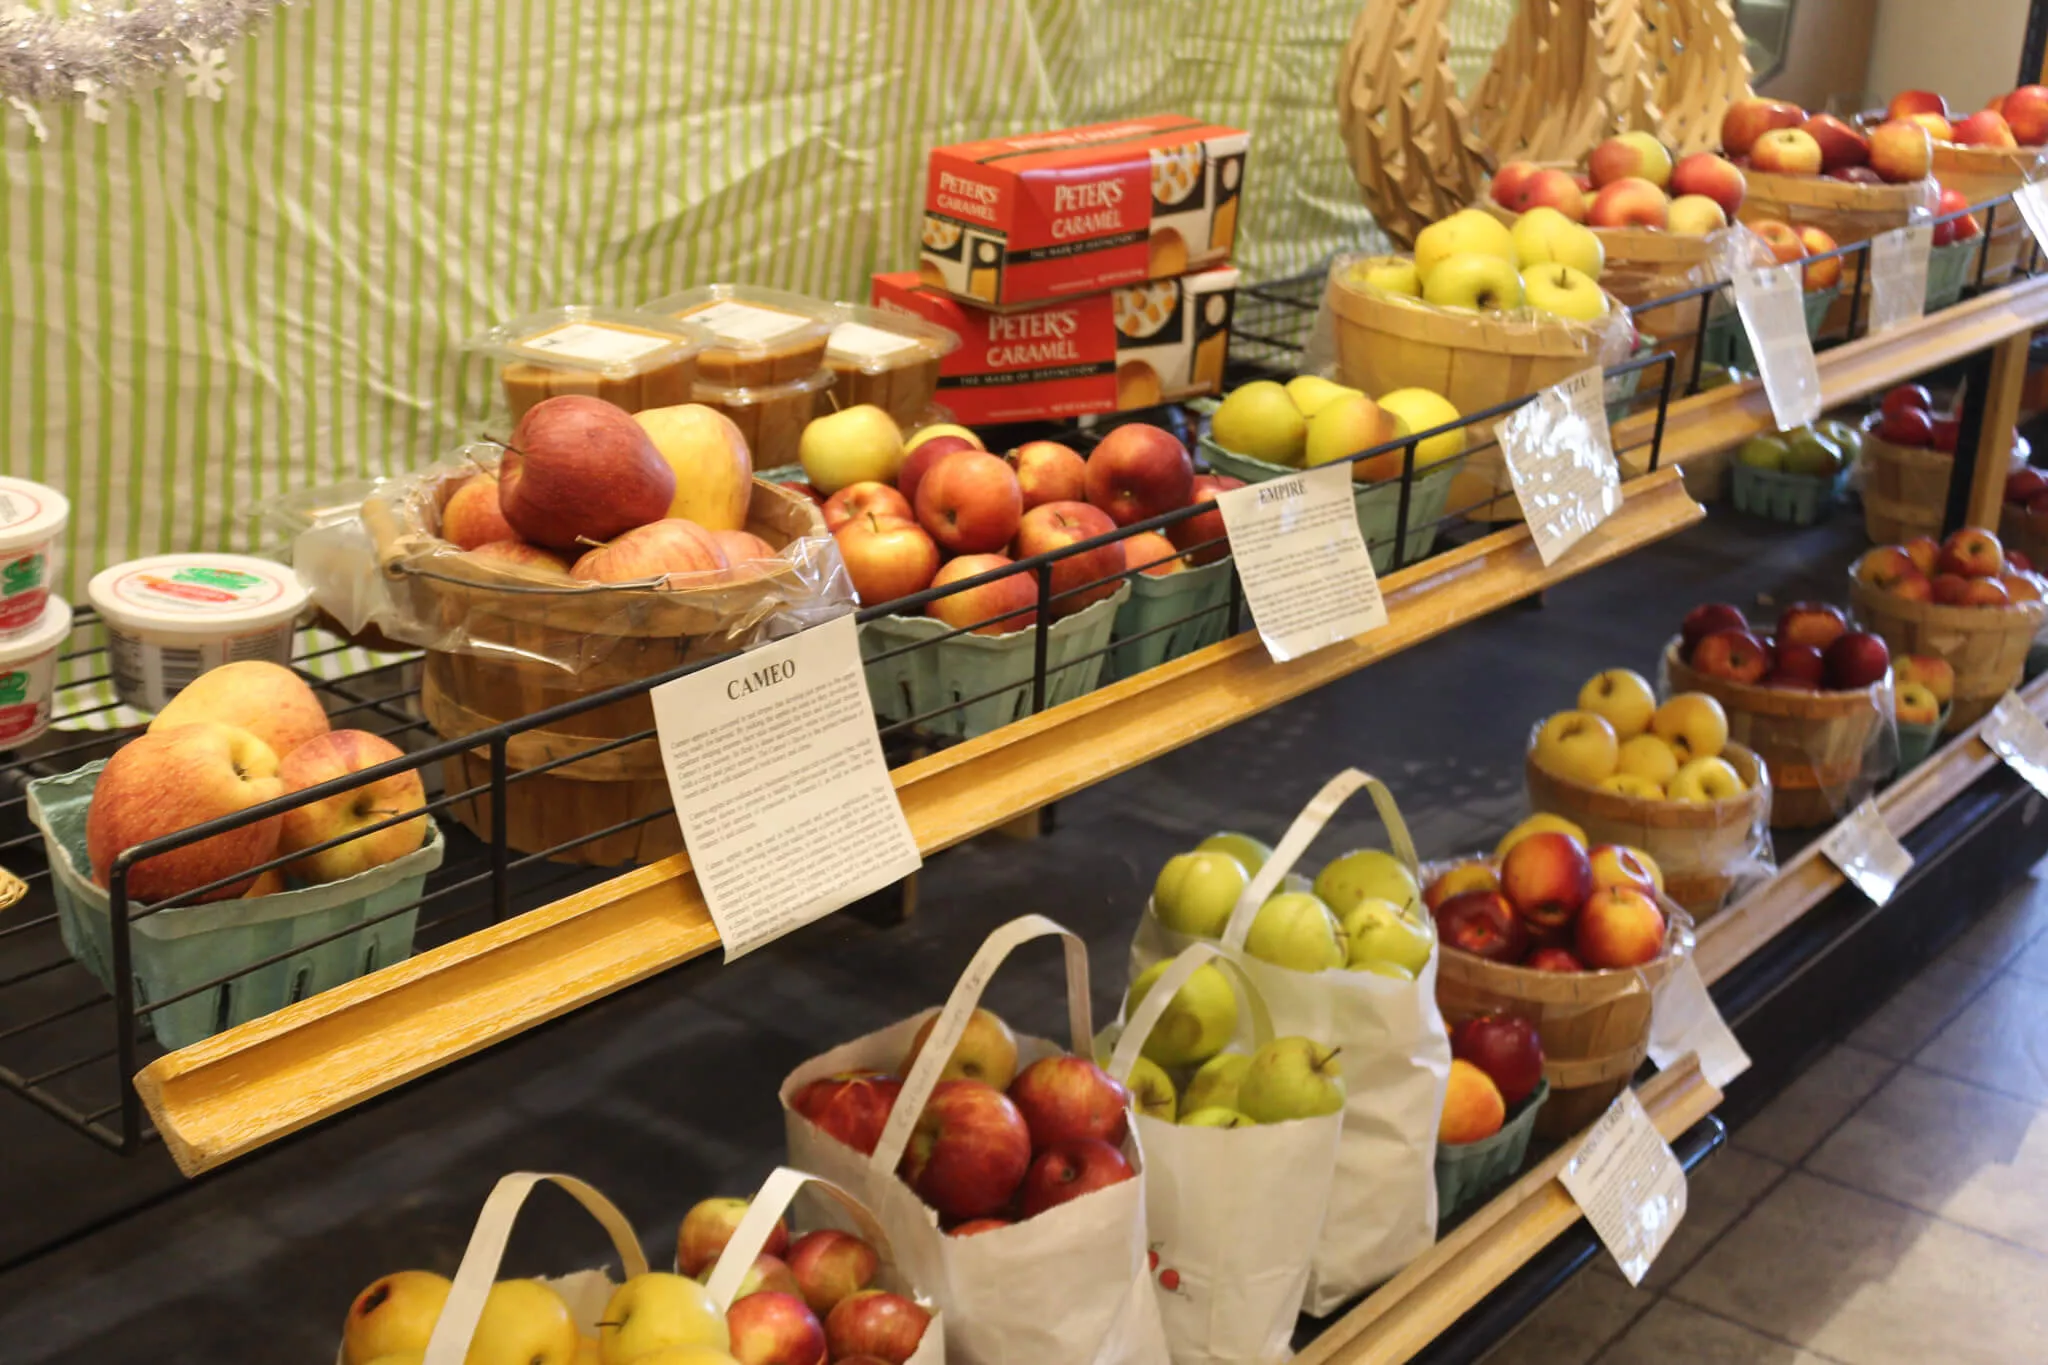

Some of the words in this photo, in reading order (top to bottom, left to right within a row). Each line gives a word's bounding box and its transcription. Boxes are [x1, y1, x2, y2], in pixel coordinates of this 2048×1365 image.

[939, 170, 1000, 204] PETER'S
[1054, 178, 1125, 213] PETER'S
[936, 193, 997, 222] CARAMEL
[1051, 209, 1124, 239] CARAMEL
[988, 308, 1080, 342] PETER'S
[986, 339, 1080, 367] CARAMEL
[1259, 480, 1307, 504] EMPIRE
[726, 659, 796, 700] CAMEO
